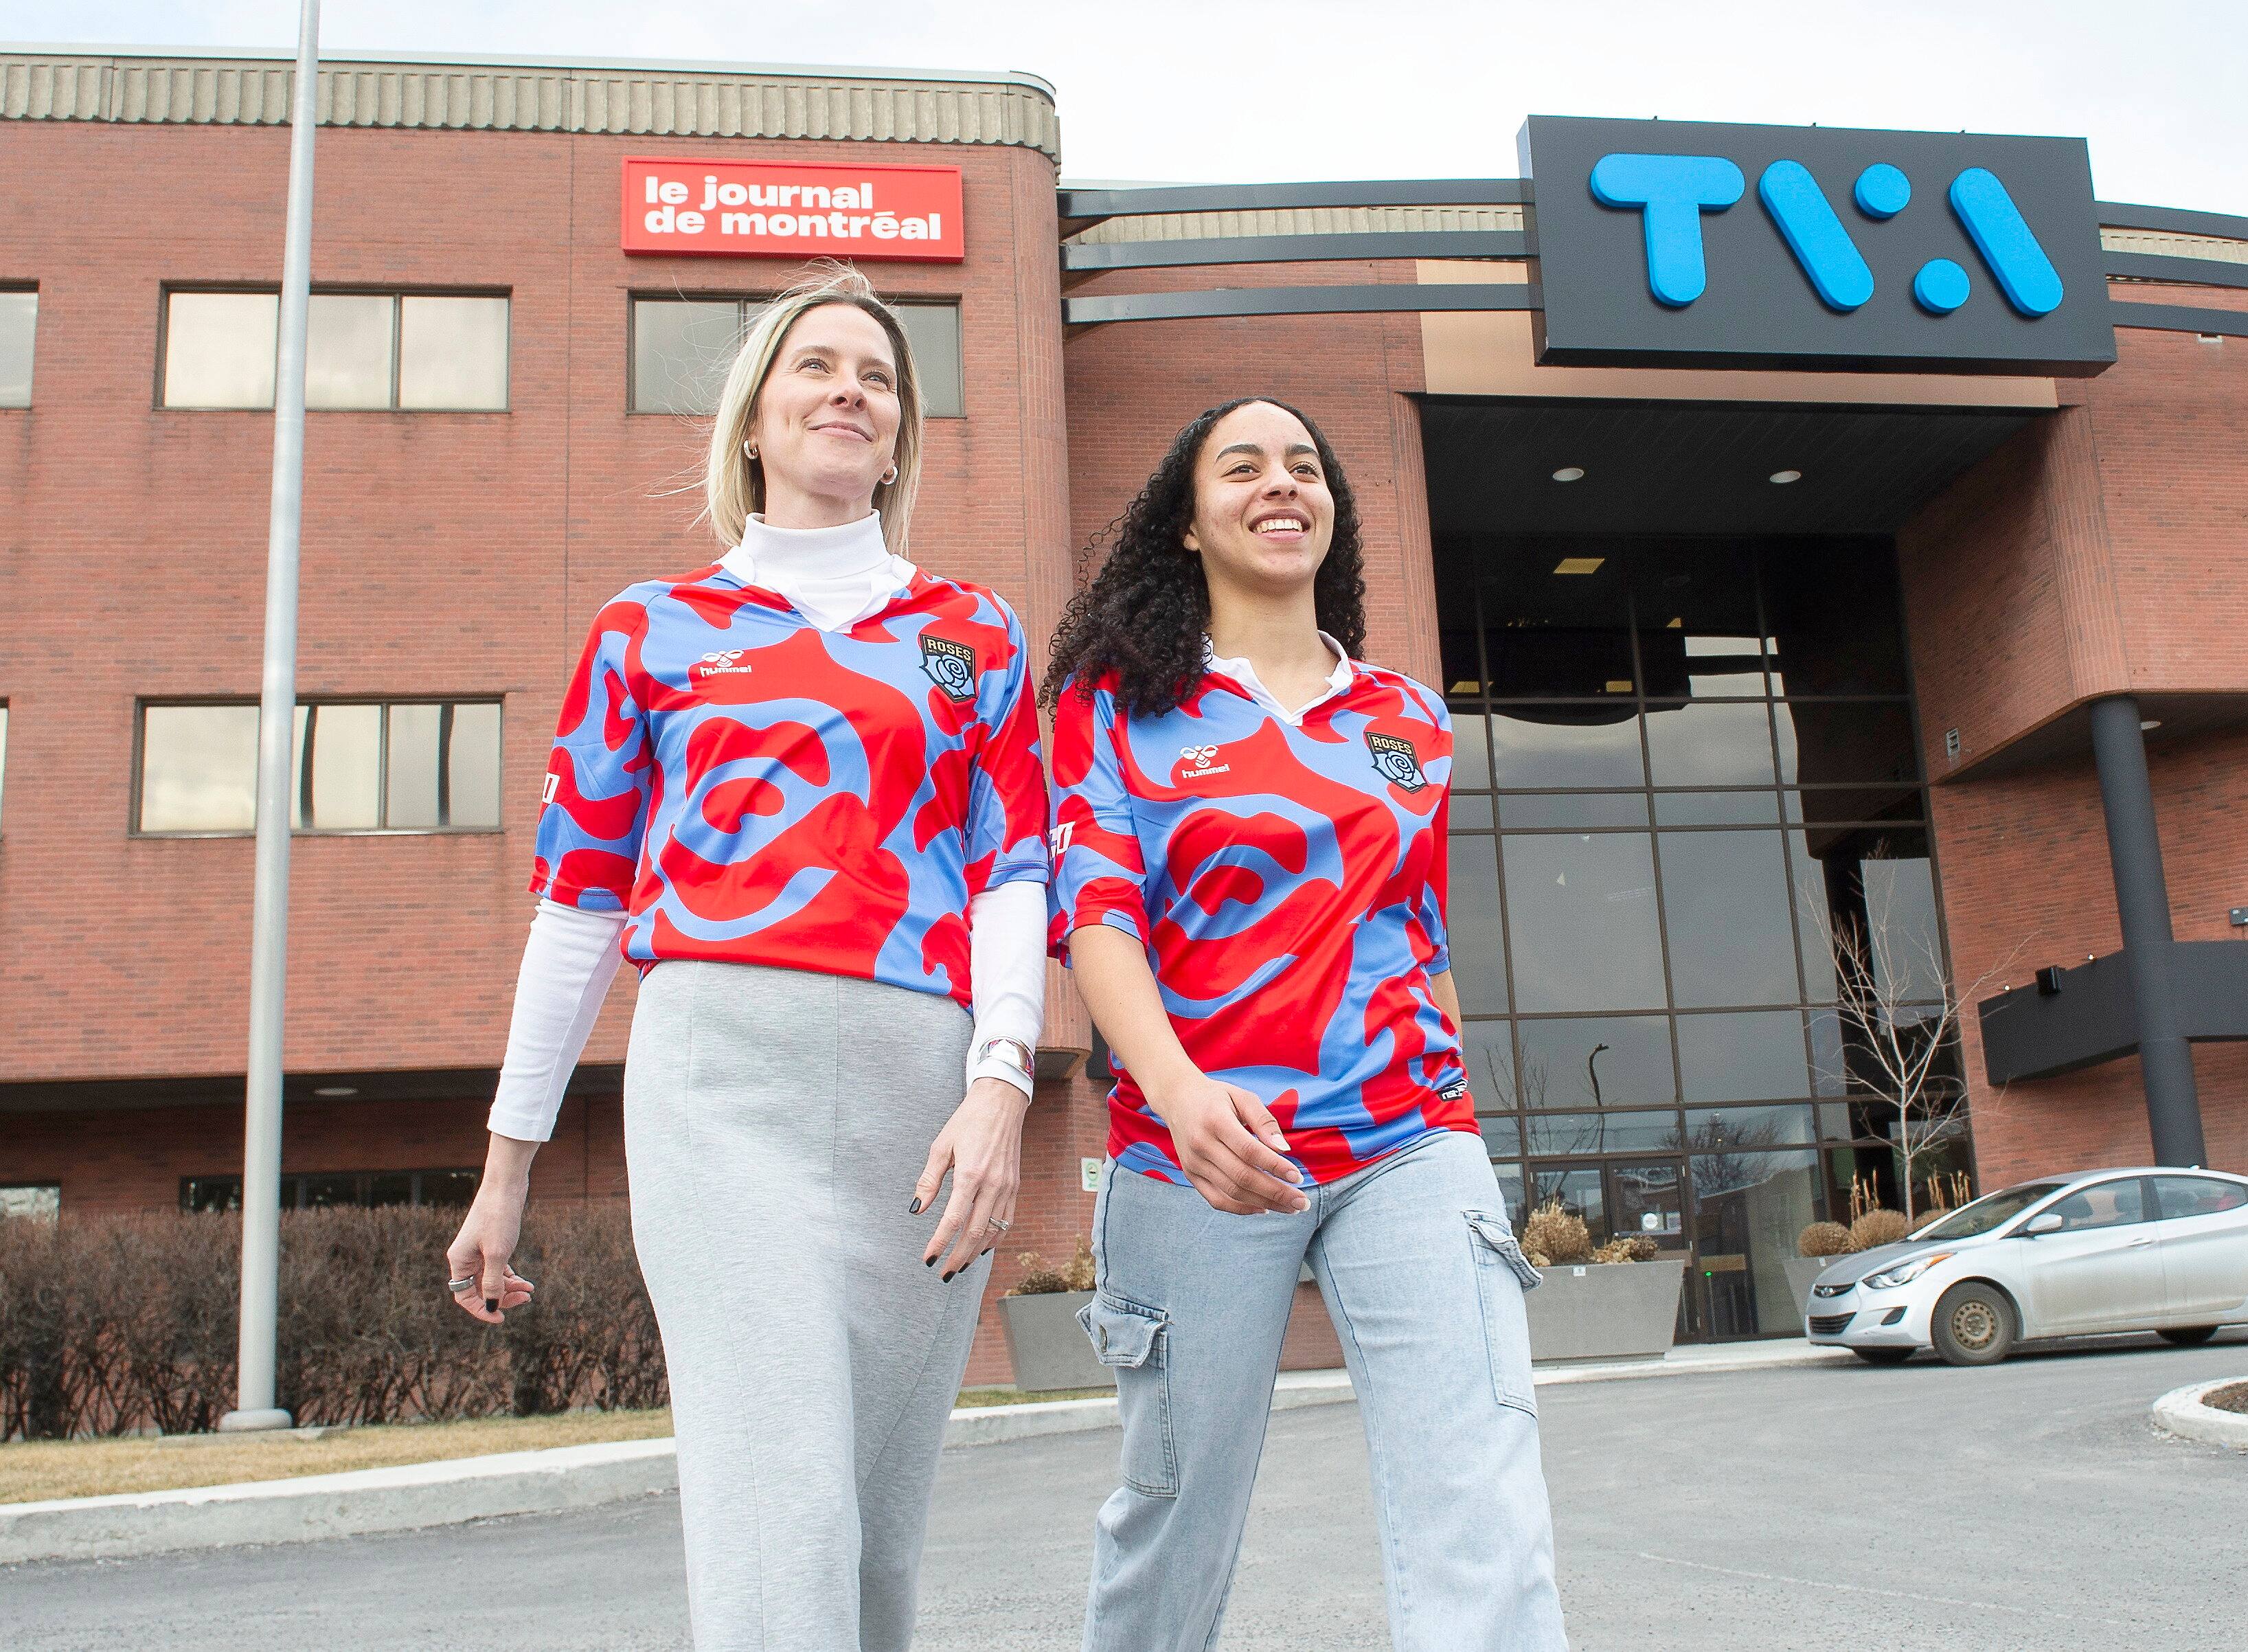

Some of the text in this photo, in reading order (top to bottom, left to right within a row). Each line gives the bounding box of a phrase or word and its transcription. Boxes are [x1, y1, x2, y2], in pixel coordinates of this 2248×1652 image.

[645, 175, 873, 210] le journal
[644, 207, 942, 240] de montréal
[927, 638, 971, 661] ROSES
[699, 664, 752, 677] hummel
[1371, 736, 1413, 754] ROSES
[1181, 763, 1230, 778] hummel
